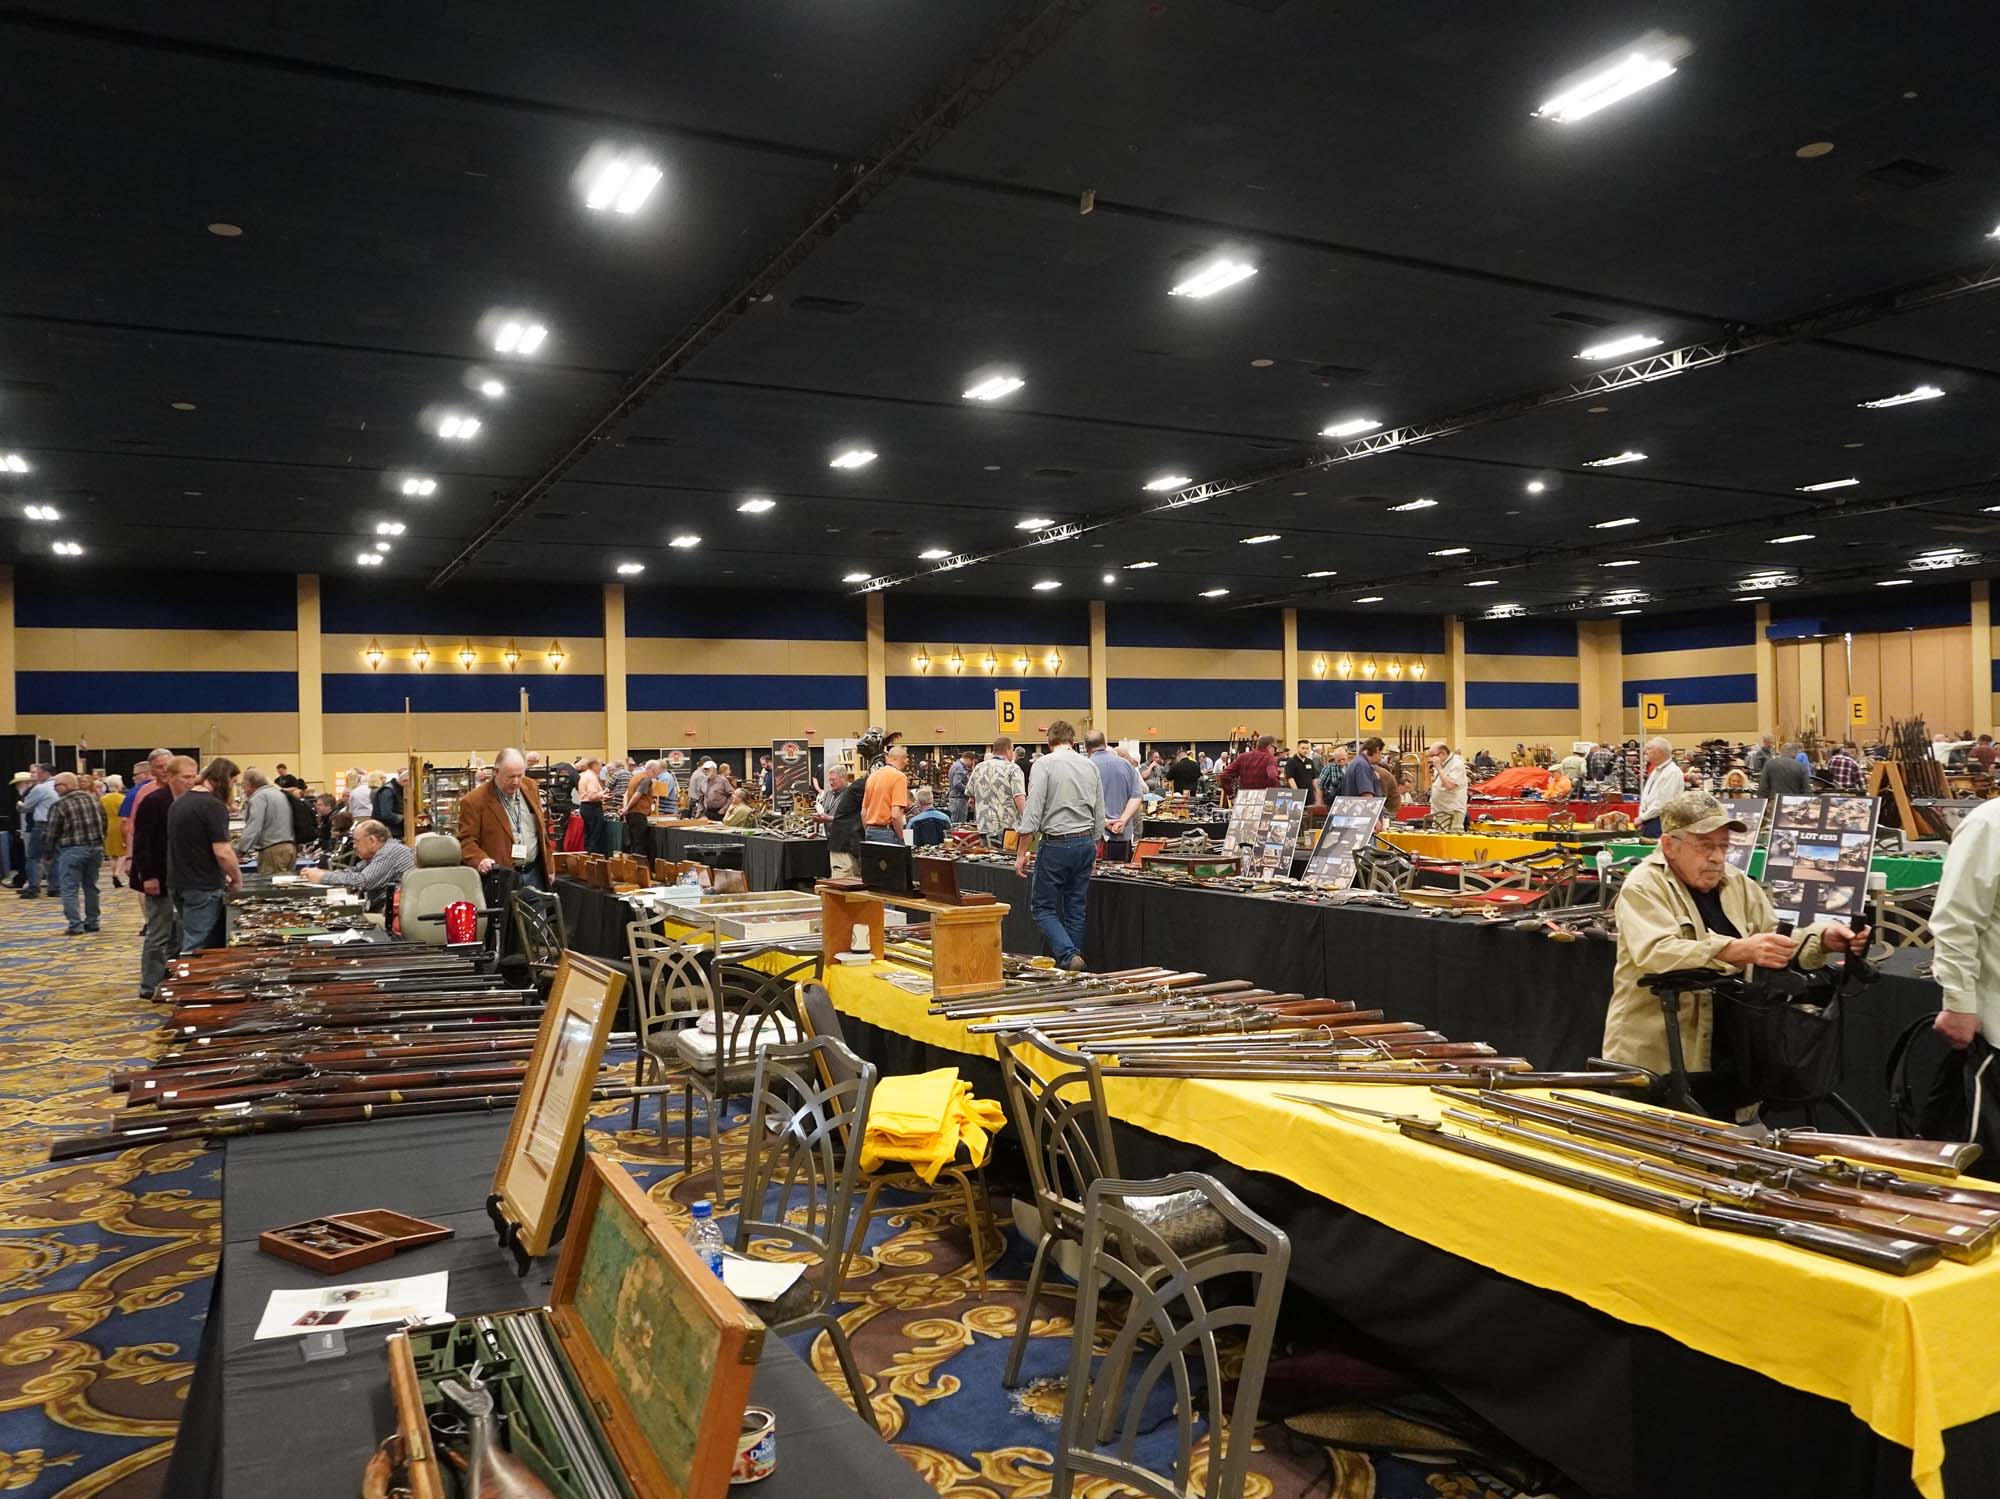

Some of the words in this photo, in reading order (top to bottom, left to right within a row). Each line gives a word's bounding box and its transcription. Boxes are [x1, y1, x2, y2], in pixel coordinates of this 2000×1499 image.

[1003, 701, 1015, 723] B
[1364, 704, 1376, 722] C
[1647, 702, 1658, 720] D
[1853, 703, 1863, 718] E
[1800, 831, 1819, 841] LOT
